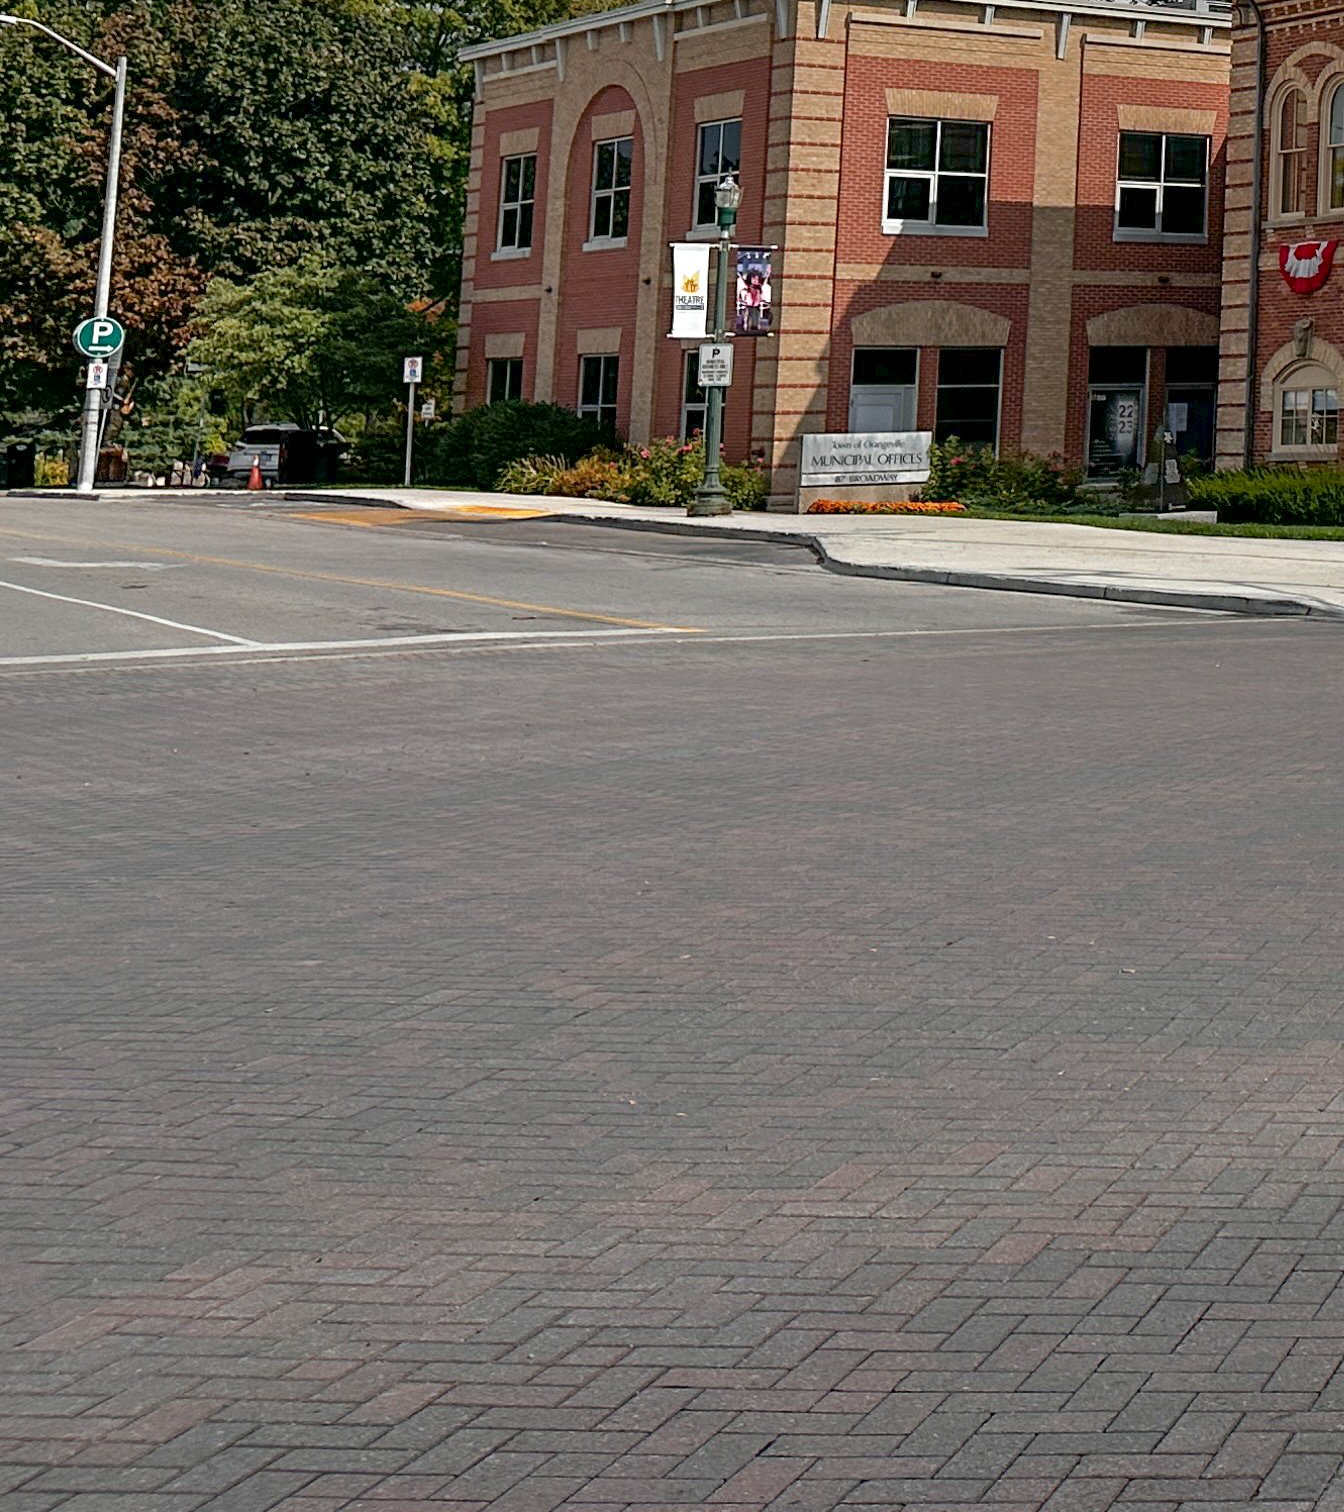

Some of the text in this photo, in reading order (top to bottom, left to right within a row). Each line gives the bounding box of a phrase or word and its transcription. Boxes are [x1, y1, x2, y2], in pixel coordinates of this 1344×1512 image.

[675, 295, 704, 304] THEATRE
[92, 321, 114, 344] P
[712, 349, 720, 358] P
[811, 453, 922, 467] MUNICIPAL OFFICES
[849, 475, 898, 483] BROADWAY
